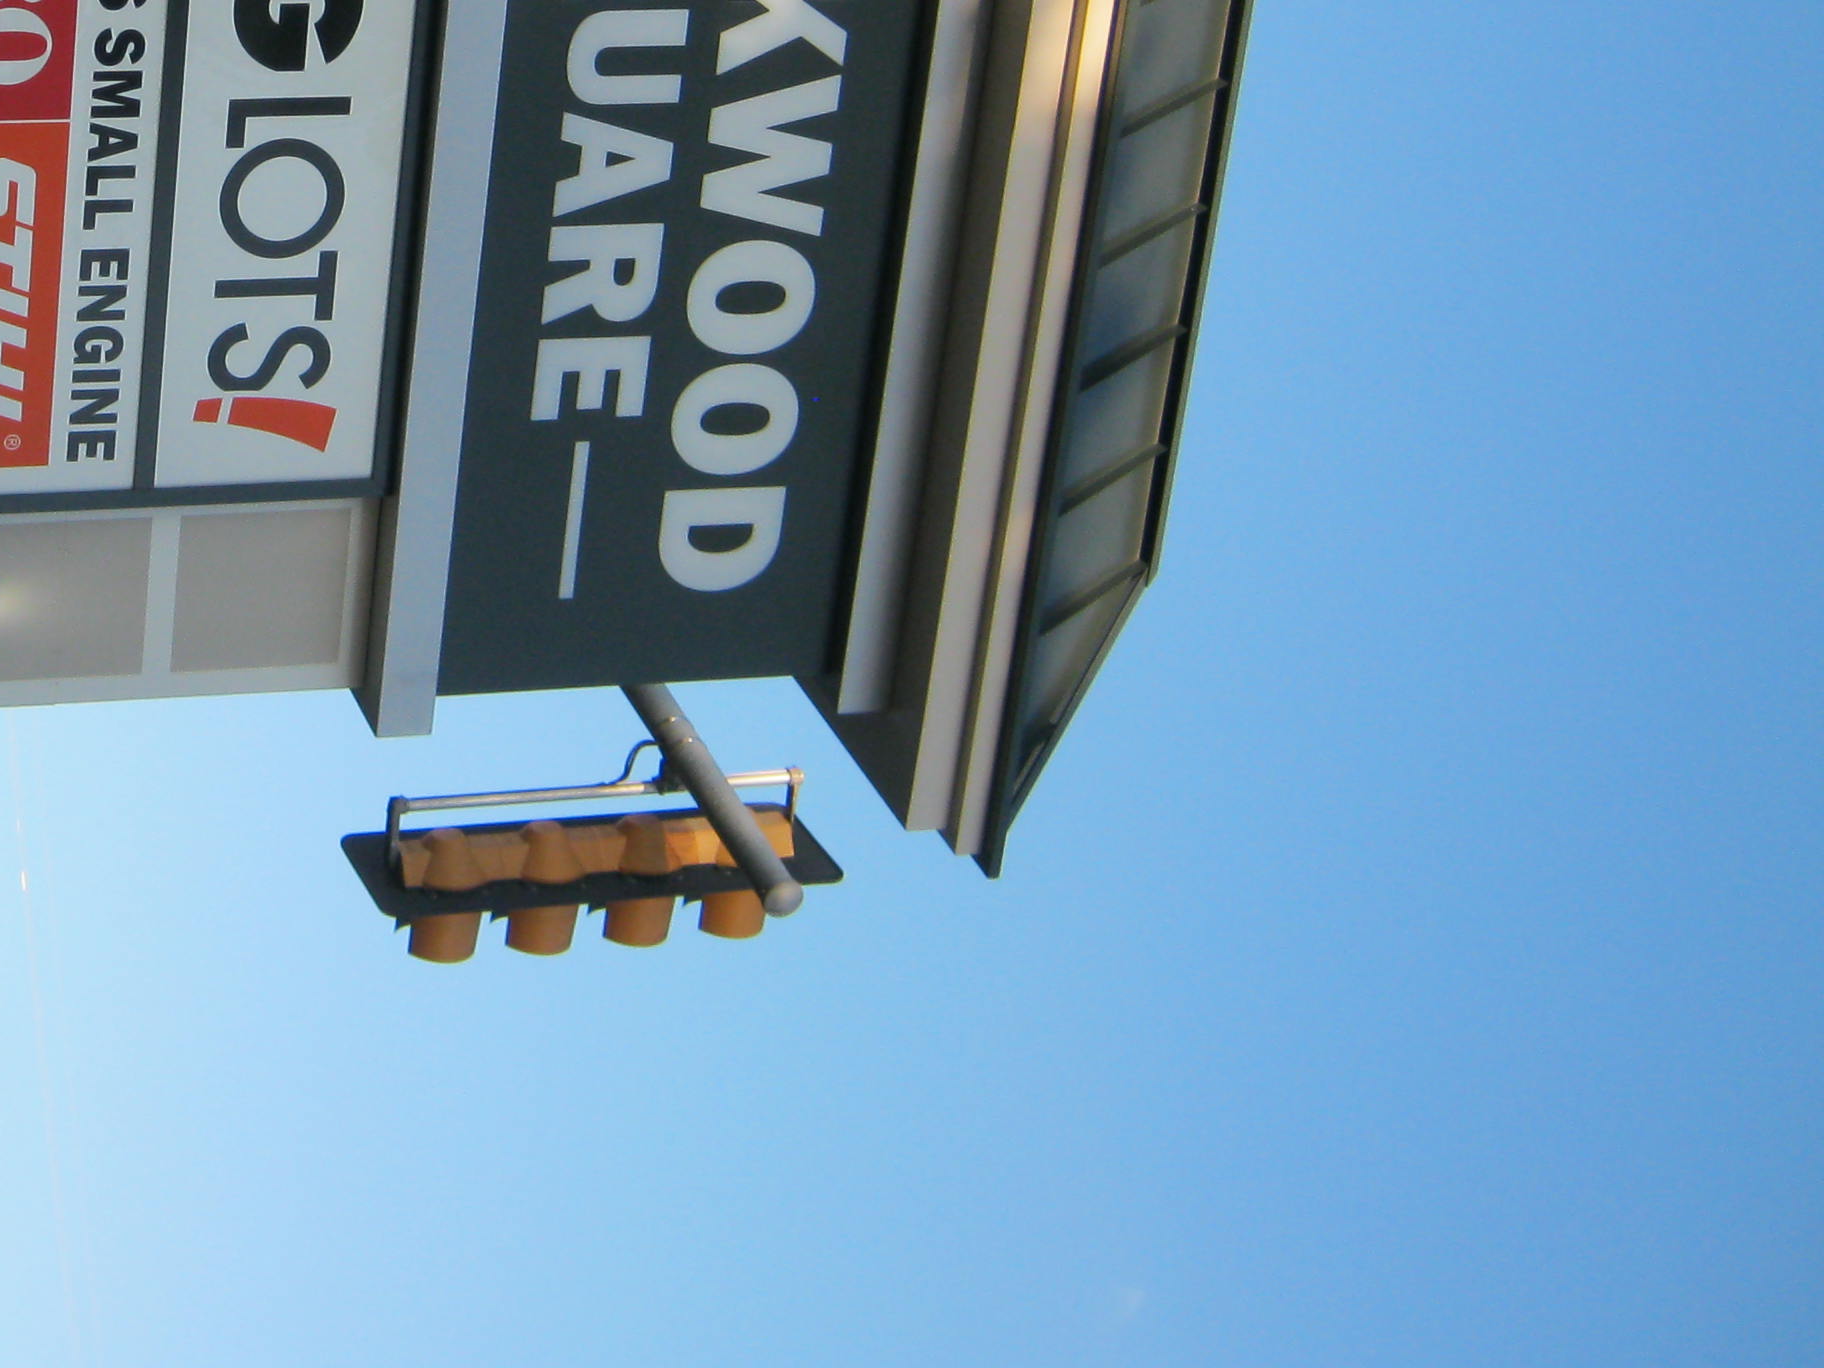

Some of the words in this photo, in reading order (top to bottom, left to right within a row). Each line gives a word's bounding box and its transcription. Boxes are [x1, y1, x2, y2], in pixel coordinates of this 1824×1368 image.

[82, 28, 146, 230] SMALL
[66, 248, 130, 462] ENGINE
[192, 97, 352, 452] LOTS!
